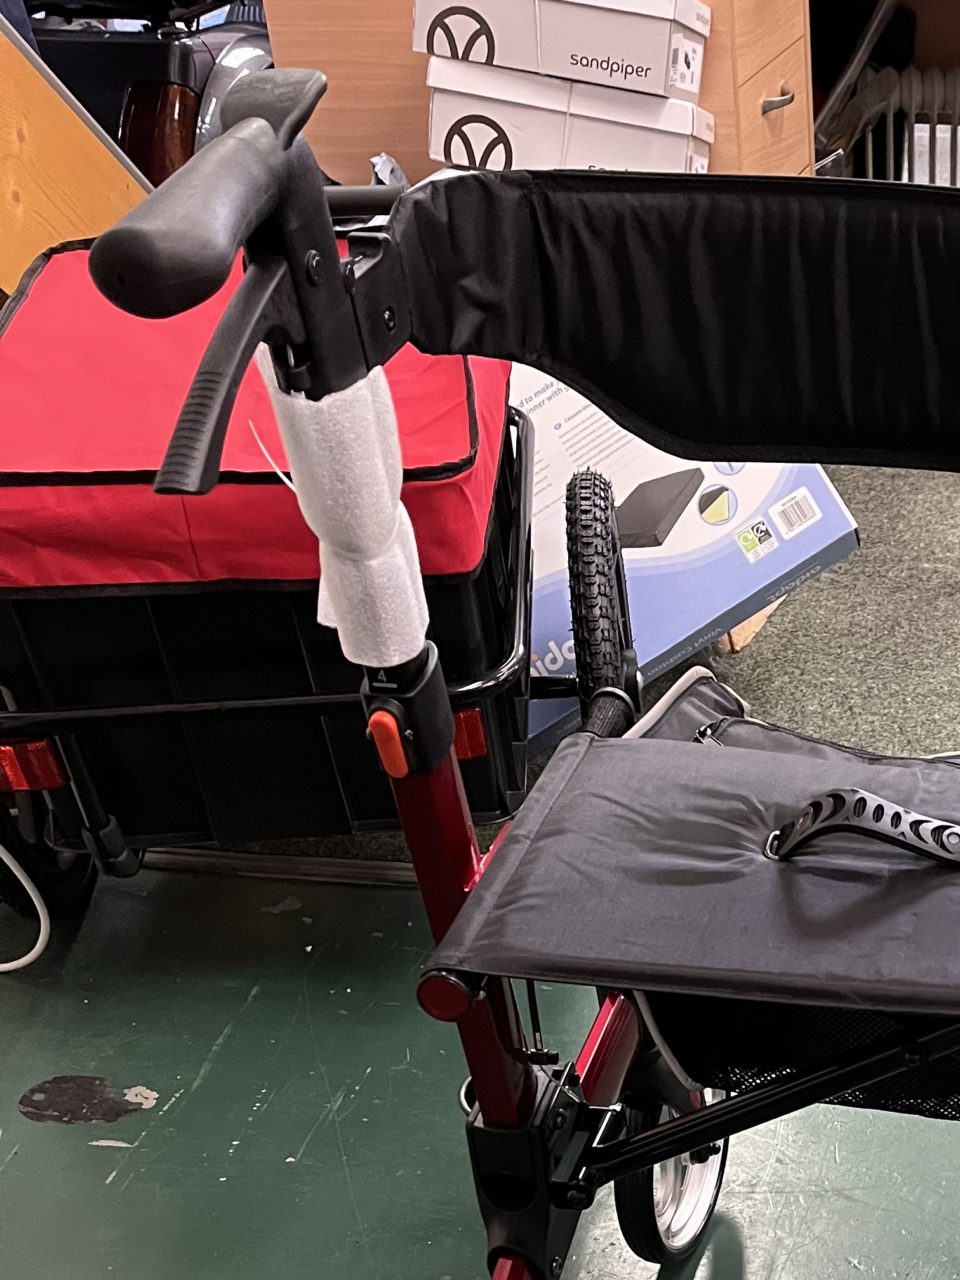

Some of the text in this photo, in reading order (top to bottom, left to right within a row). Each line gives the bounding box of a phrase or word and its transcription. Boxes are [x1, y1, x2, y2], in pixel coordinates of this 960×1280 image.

[570, 53, 652, 81] sandpiper
[533, 381, 555, 398] make
[545, 387, 563, 402] with
[377, 669, 387, 682] 4
